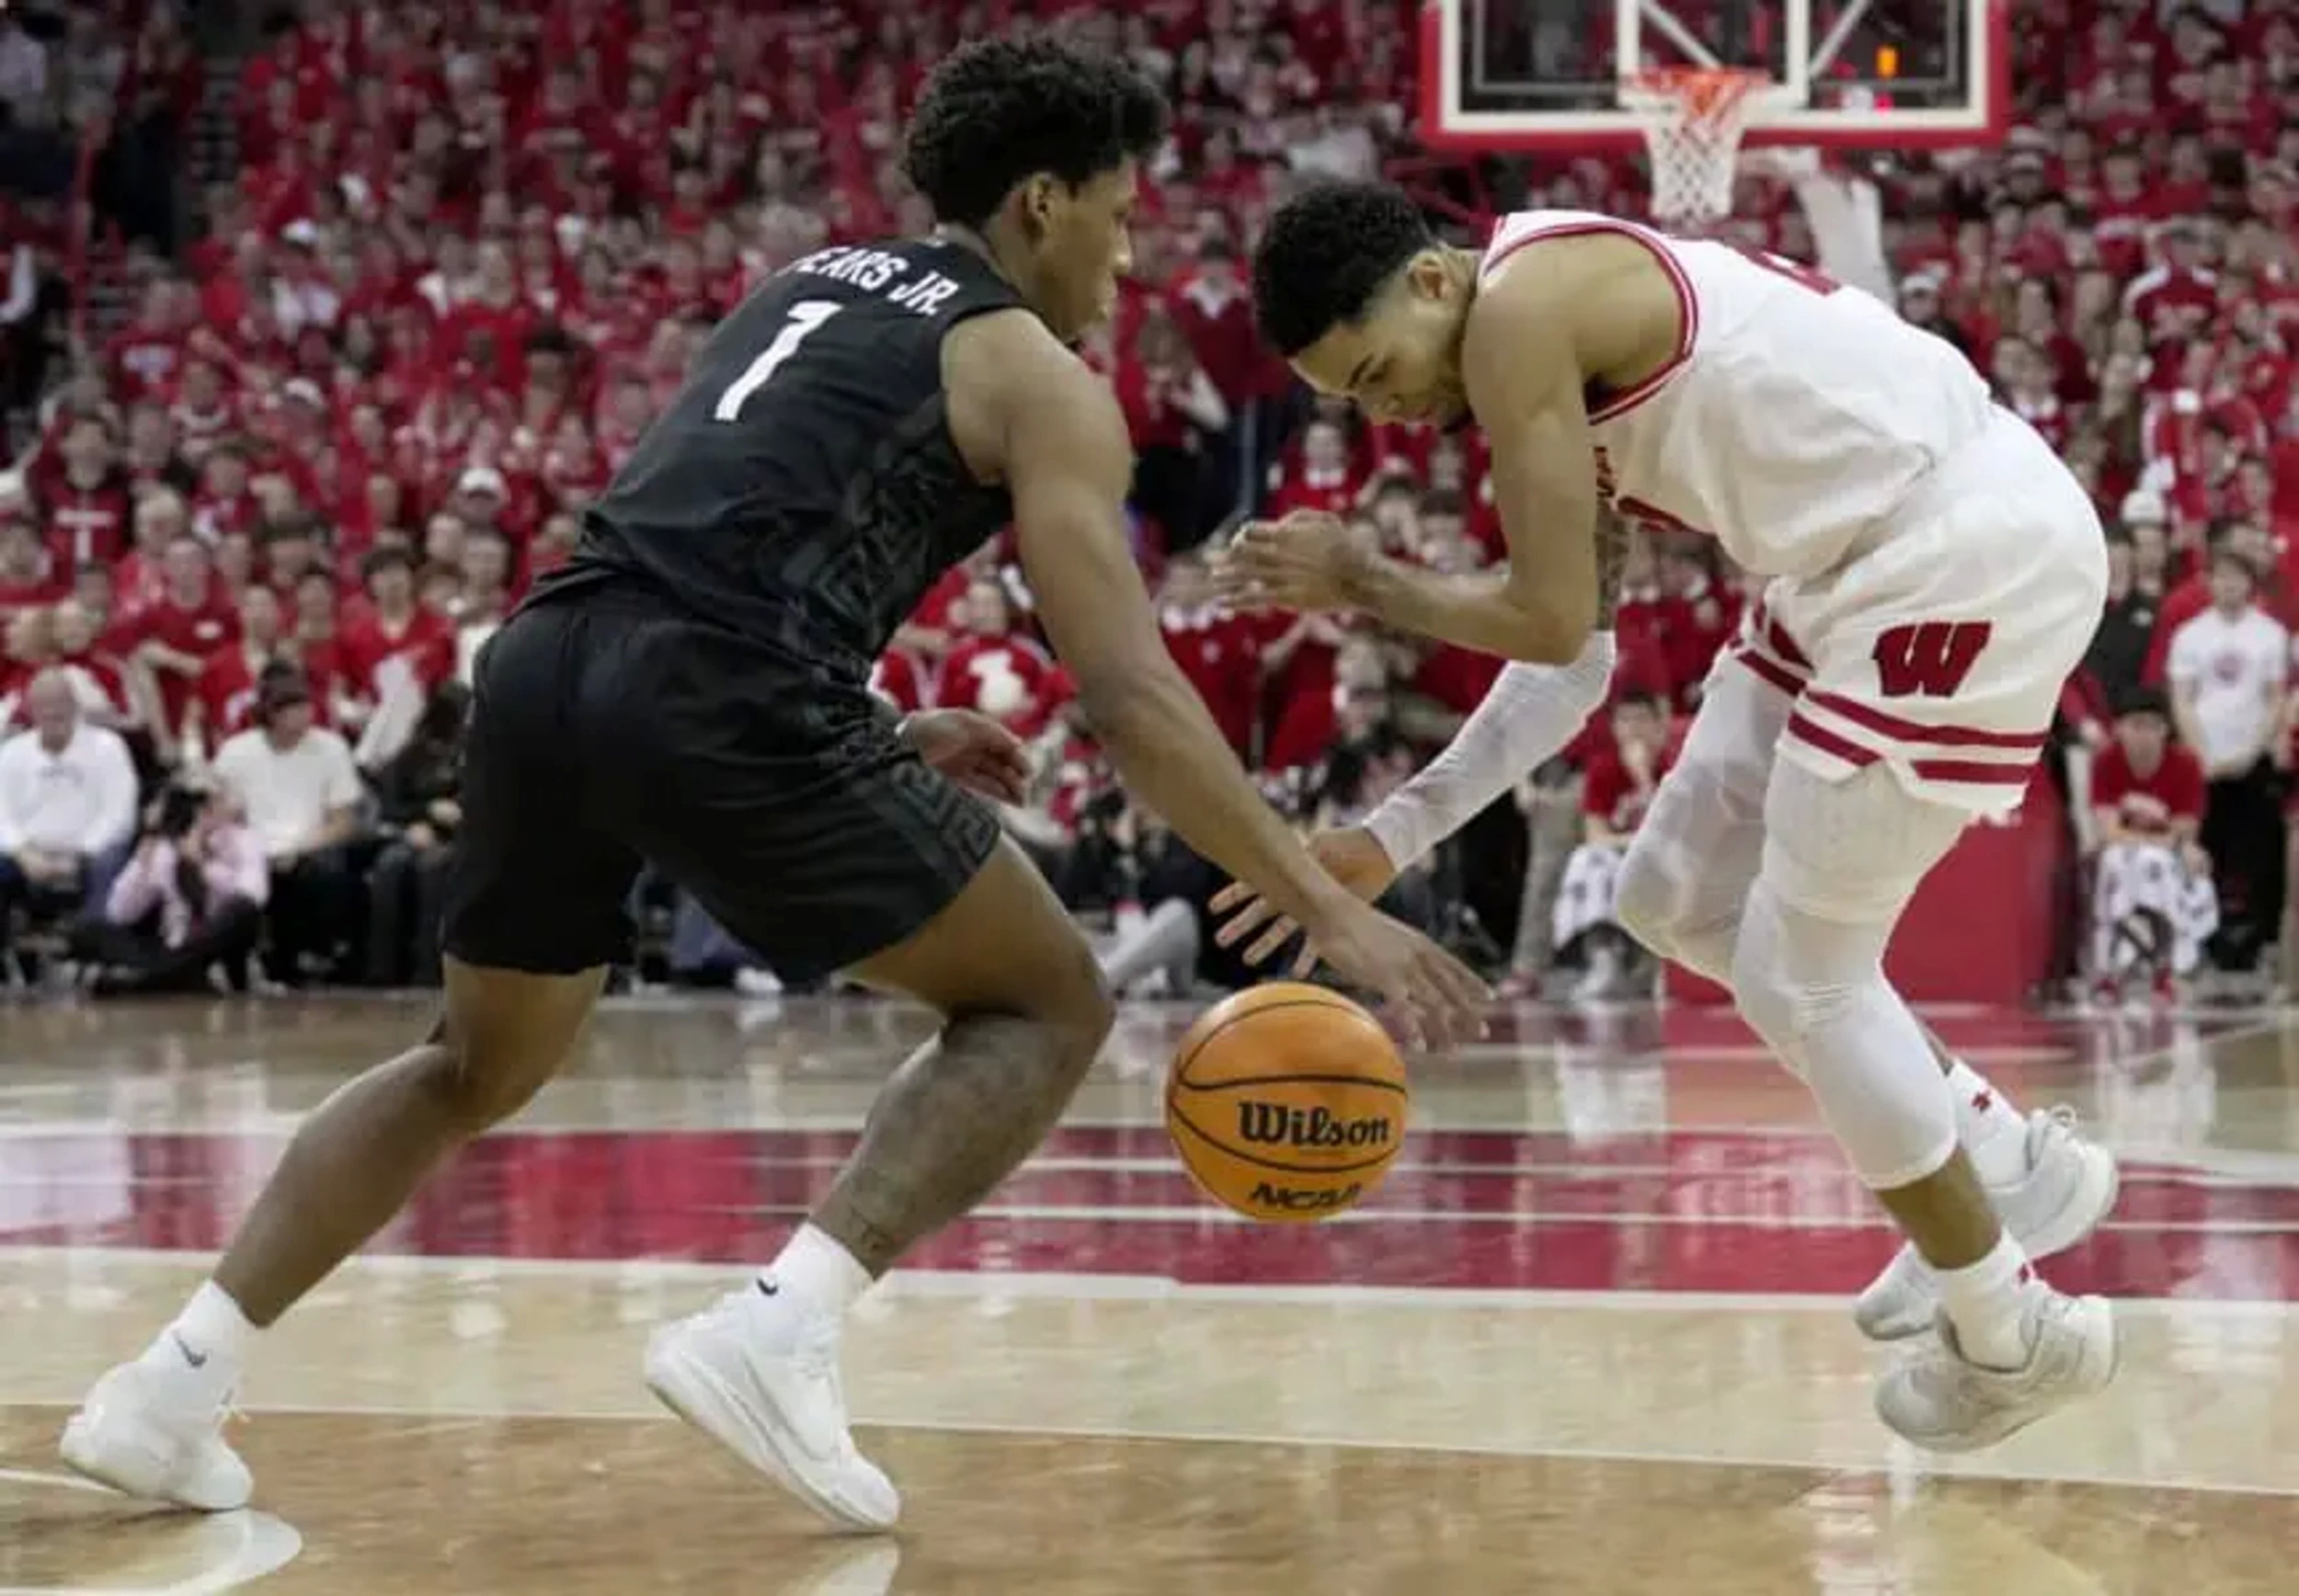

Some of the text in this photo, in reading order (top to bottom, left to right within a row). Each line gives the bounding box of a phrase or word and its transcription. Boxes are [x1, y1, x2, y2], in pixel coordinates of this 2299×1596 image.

[777, 245, 958, 315] EARS JR.
[715, 302, 843, 420] 1
[1871, 622, 1991, 698] W
[1239, 1101, 1390, 1146] Wilson
